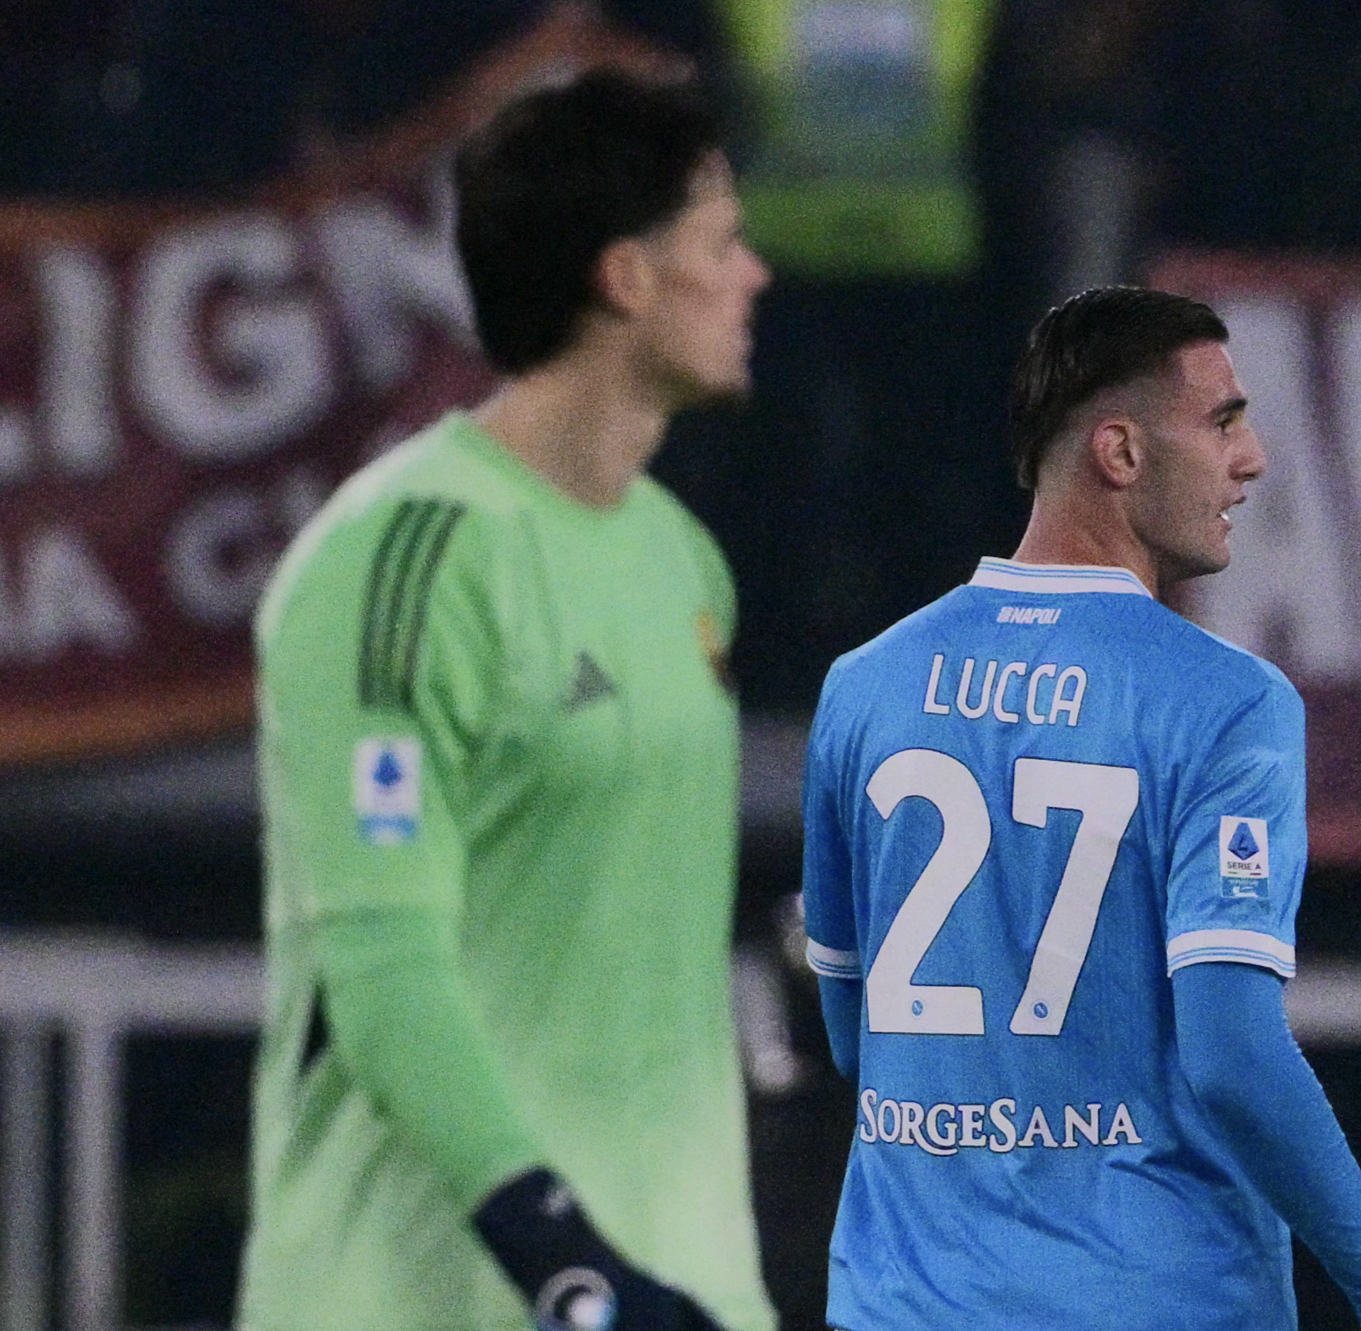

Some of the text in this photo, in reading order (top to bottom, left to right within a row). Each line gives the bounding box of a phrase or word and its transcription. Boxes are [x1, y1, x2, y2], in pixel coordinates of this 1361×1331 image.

[922, 652, 1089, 728] LUCCA
[865, 746, 1141, 1037] 27
[1227, 860, 1262, 871] SERIE A
